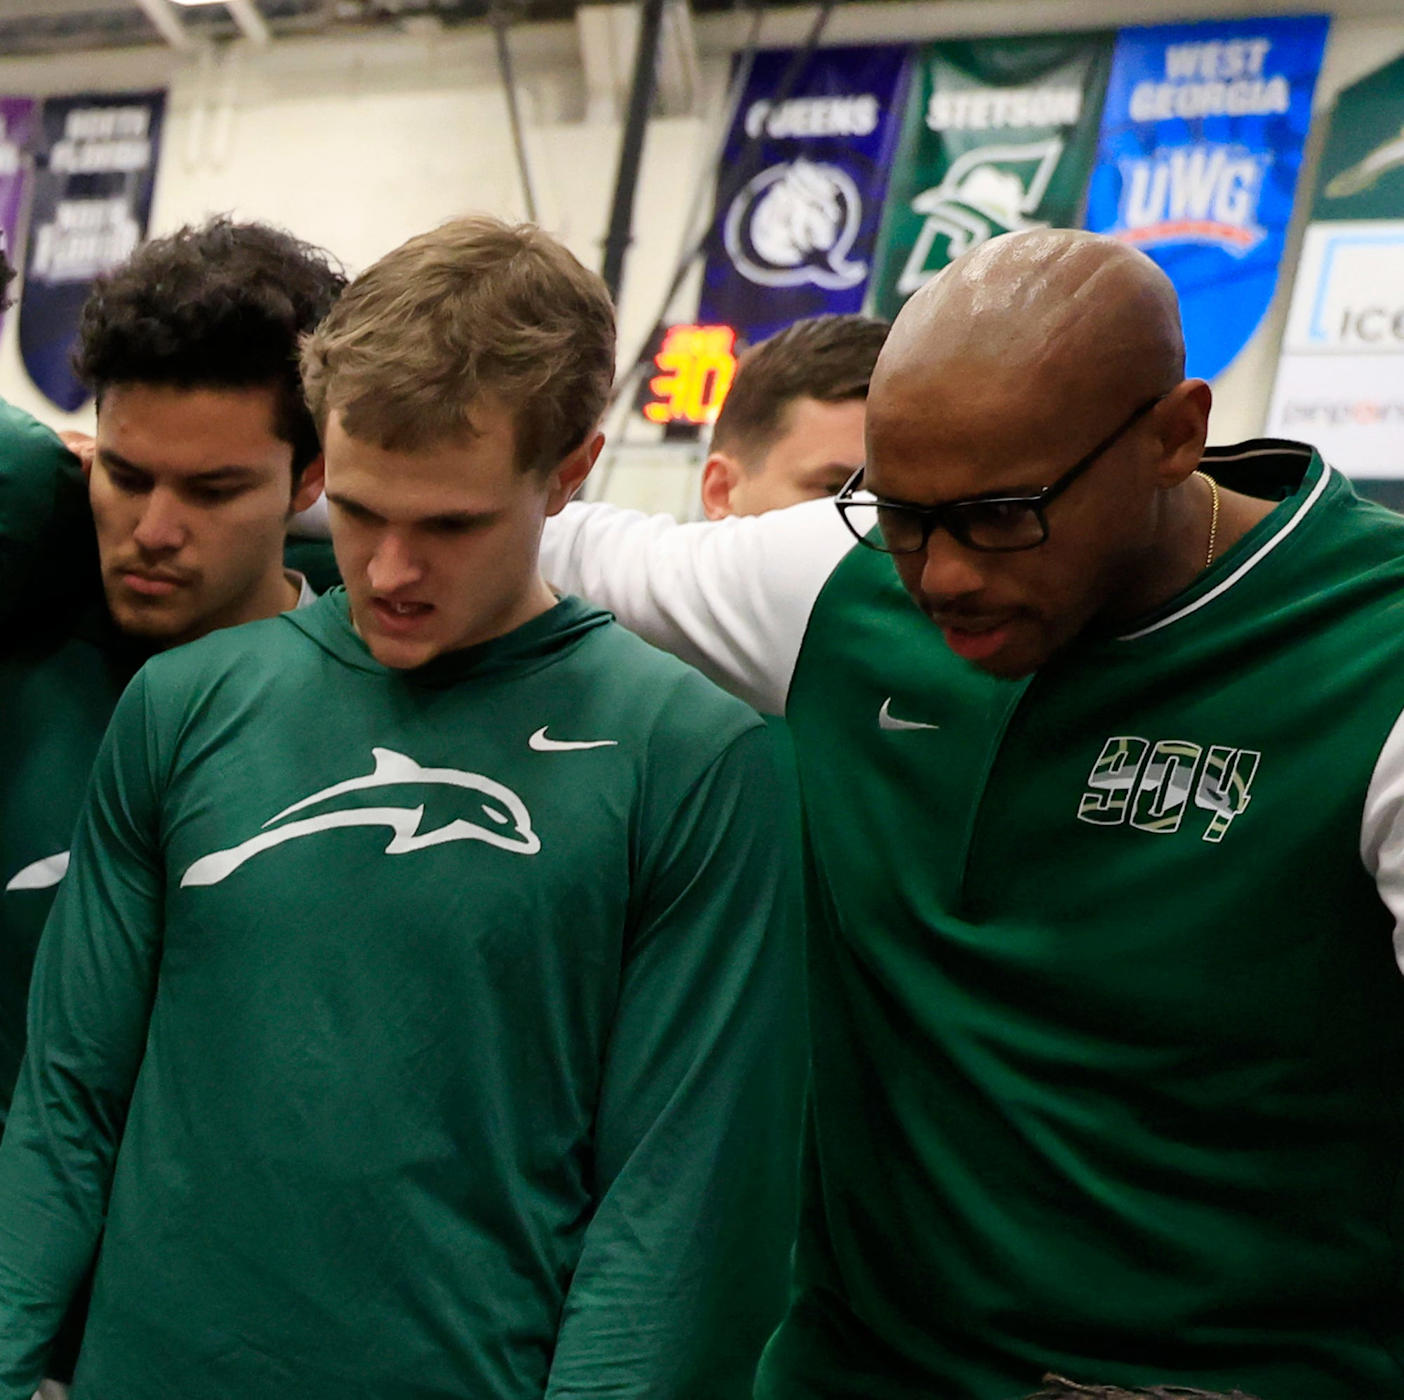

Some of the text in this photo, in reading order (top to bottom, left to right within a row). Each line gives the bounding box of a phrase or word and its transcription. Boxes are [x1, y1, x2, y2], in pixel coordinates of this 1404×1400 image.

[1166, 39, 1271, 79] WEST
[1129, 75, 1290, 122] GEORGIA
[1126, 148, 1257, 226] UWG
[1077, 735, 1262, 843] 904
